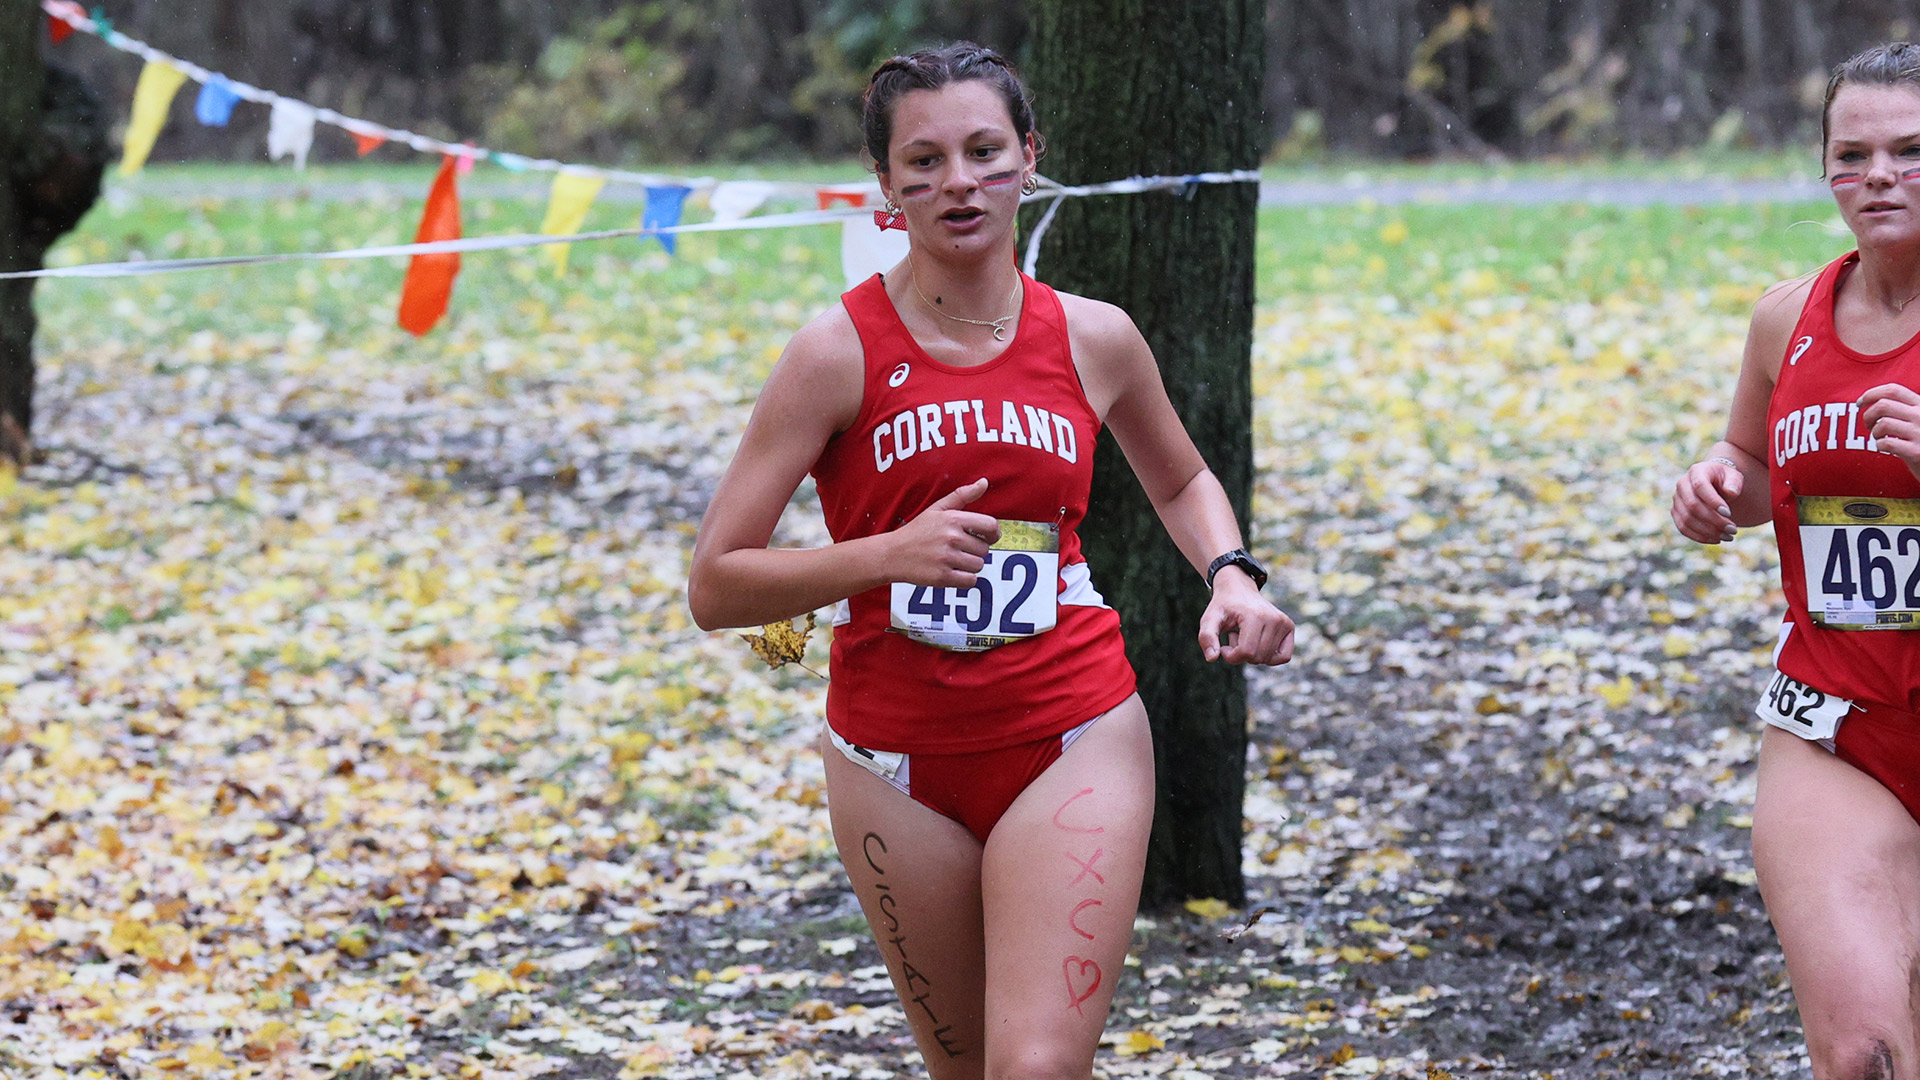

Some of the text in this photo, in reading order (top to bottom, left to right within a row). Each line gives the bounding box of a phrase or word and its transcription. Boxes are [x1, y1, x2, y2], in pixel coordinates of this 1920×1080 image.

[873, 399, 1077, 473] CORTLAND
[1774, 402, 1899, 468] CORTL
[908, 553, 1038, 634] 452
[1821, 527, 1920, 610] 462
[1769, 673, 1826, 728] 462
